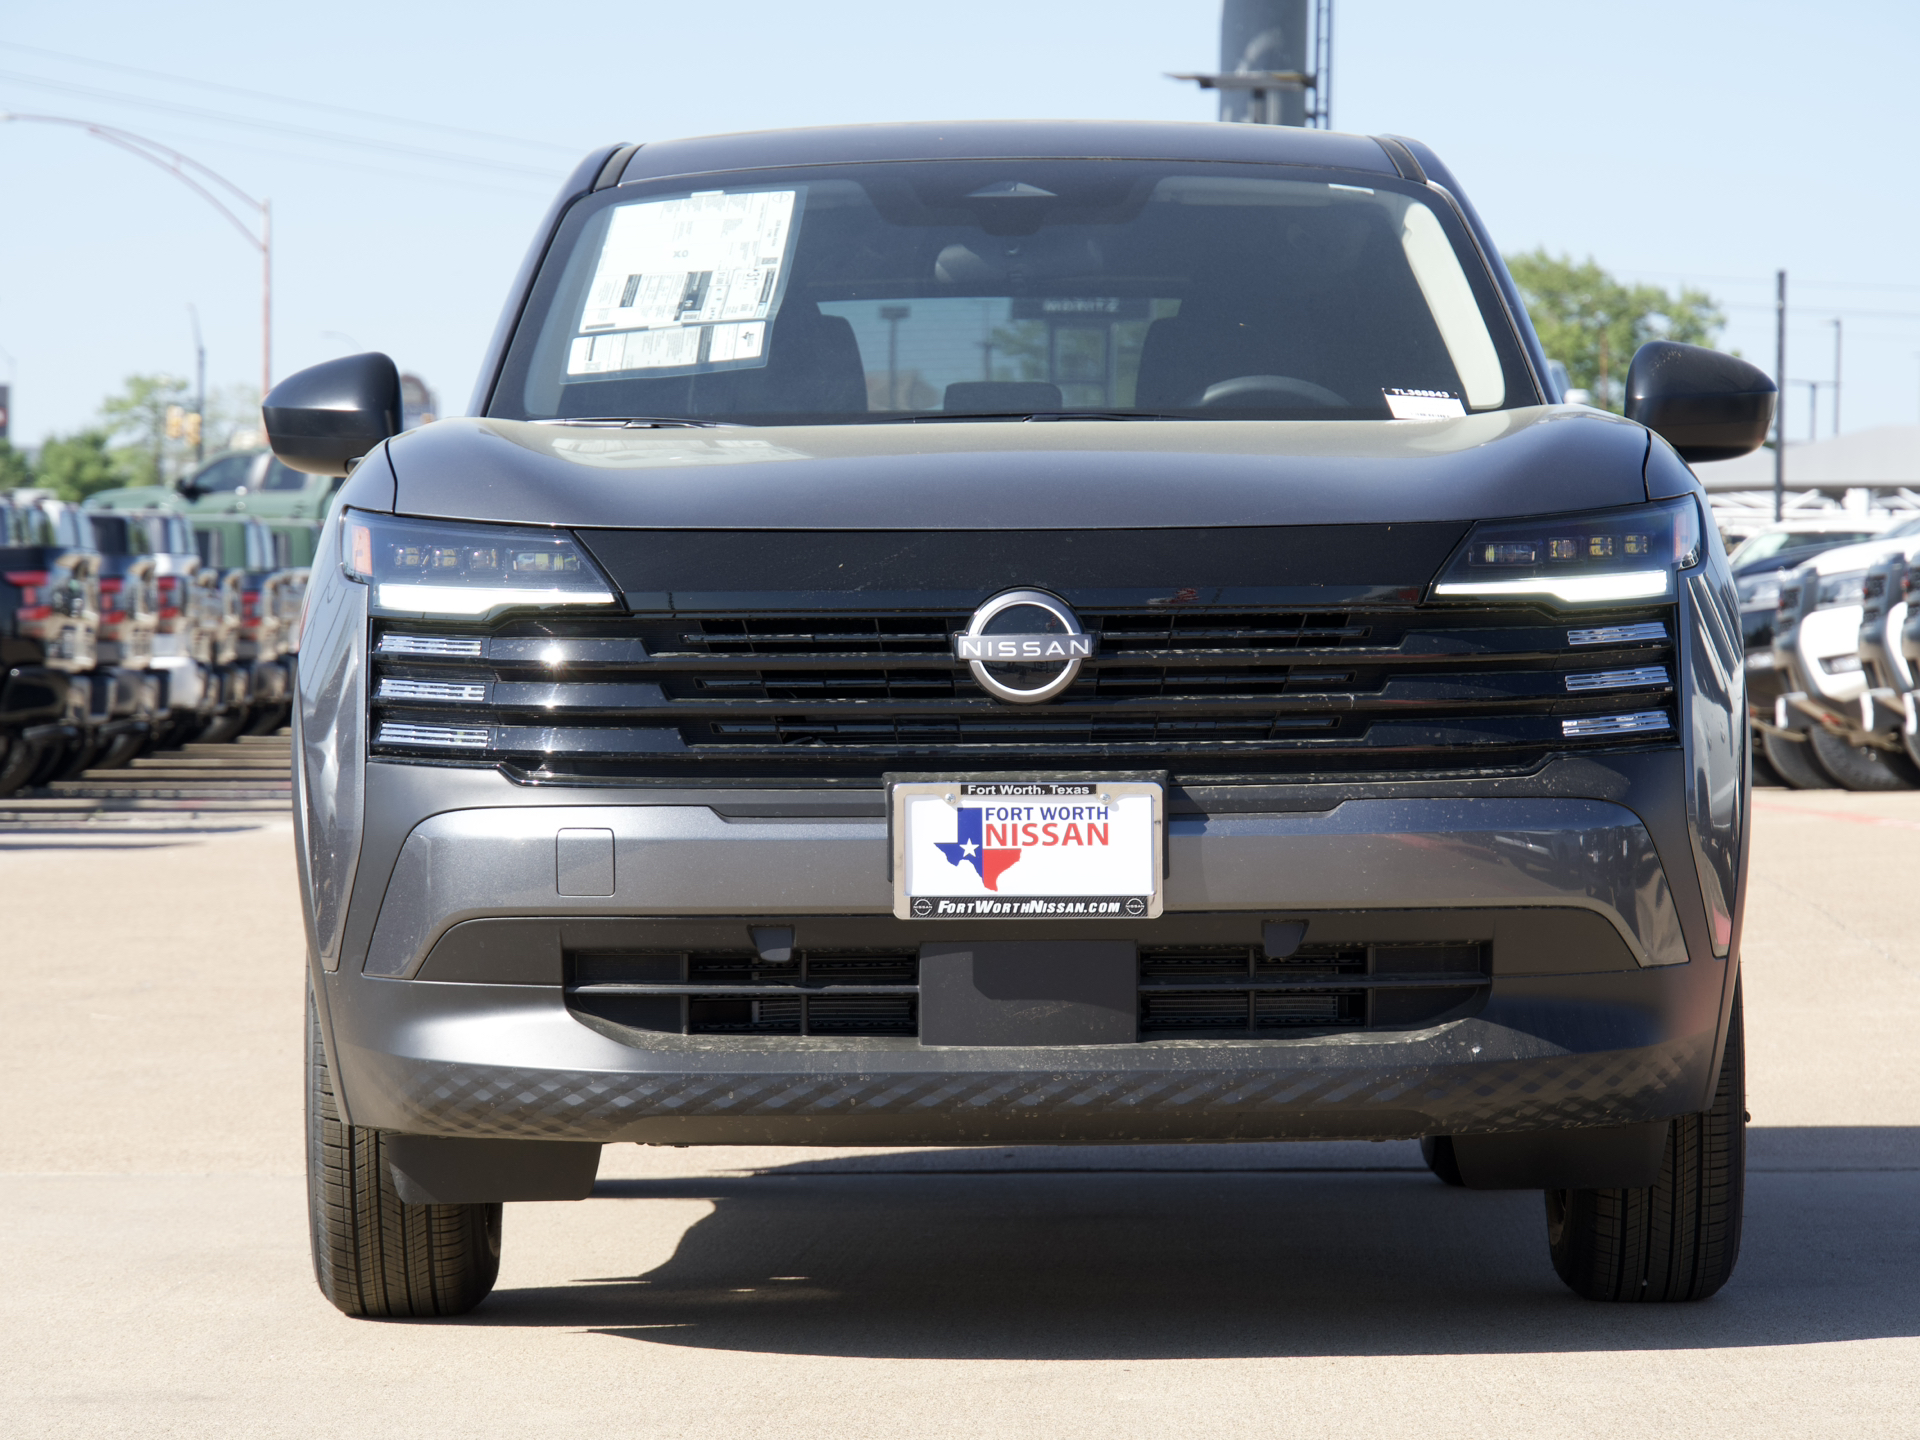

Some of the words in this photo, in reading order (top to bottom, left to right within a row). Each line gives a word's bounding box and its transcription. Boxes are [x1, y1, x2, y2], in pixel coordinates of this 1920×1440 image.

[962, 639, 1089, 657] NISSAN
[968, 785, 996, 795] Fort
[999, 785, 1046, 796] Worth,
[1050, 785, 1089, 795] Texas
[985, 807, 1034, 821] FORT
[1040, 806, 1109, 820] WORTH
[985, 823, 1109, 847] NISSAN
